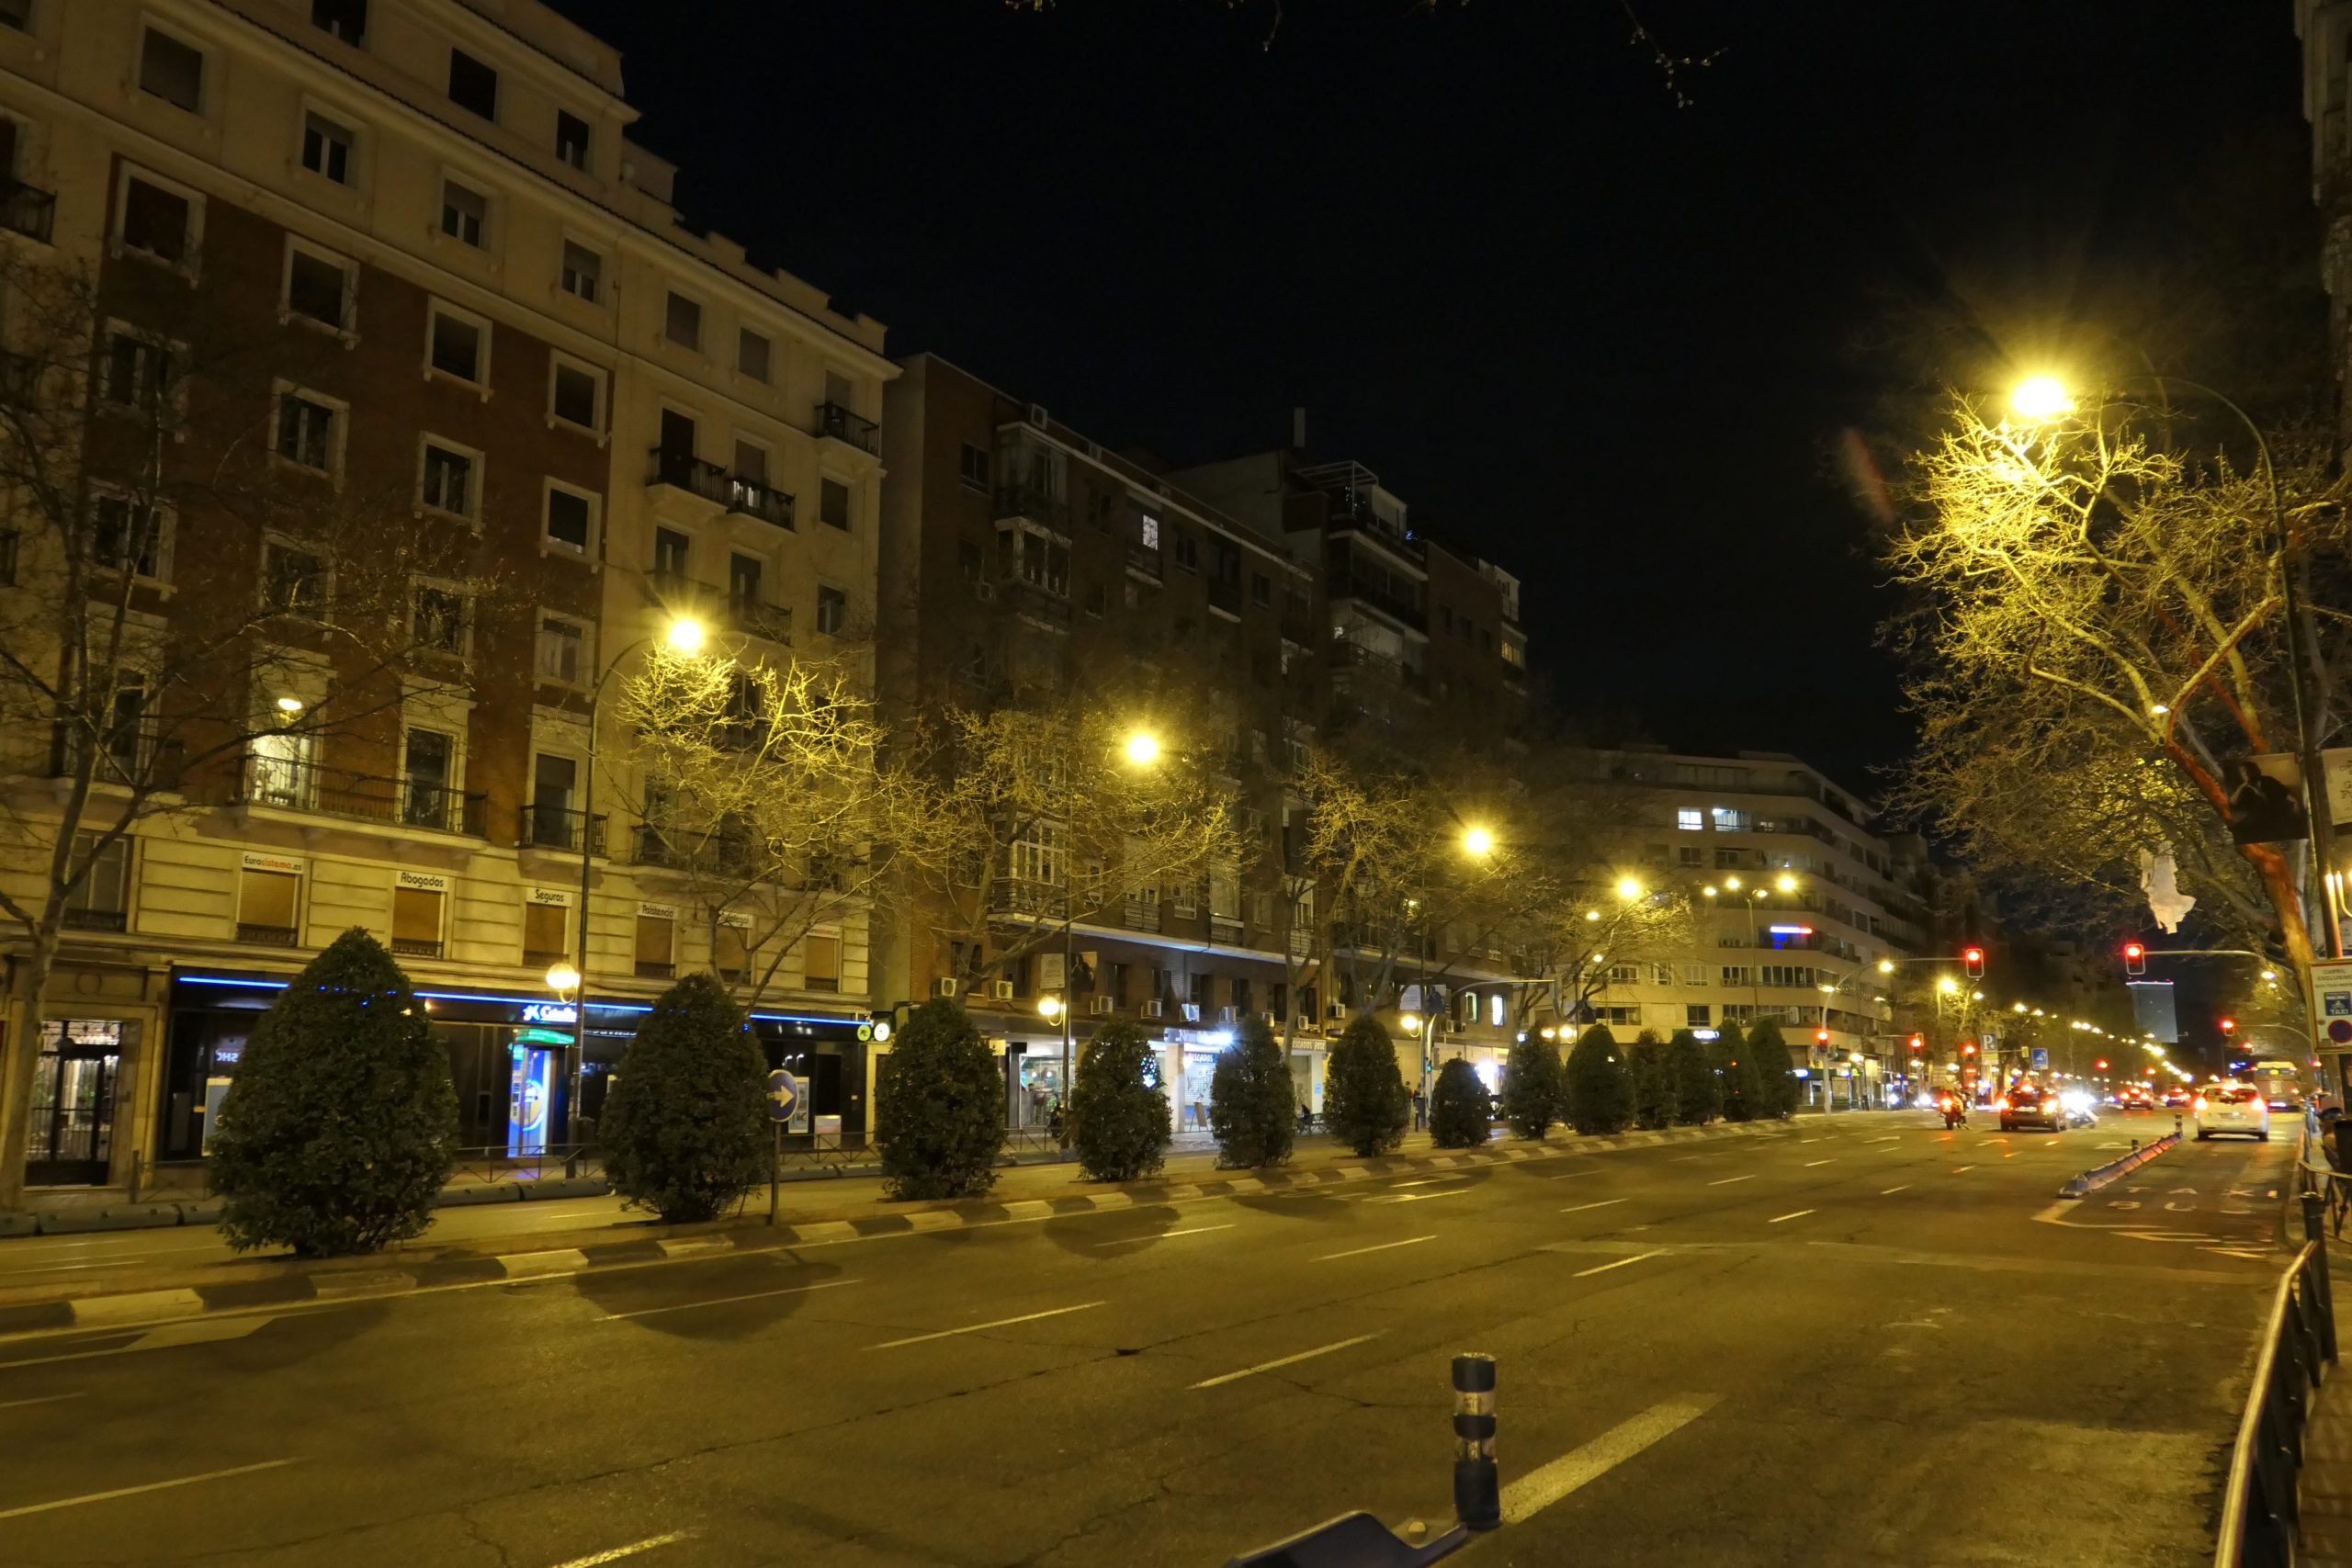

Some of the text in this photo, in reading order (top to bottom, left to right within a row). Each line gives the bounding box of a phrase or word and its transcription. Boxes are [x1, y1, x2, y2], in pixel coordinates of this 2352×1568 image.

[401, 872, 444, 887] Abogados
[535, 888, 564, 903] Seguros
[1983, 1034, 1993, 1050] P
